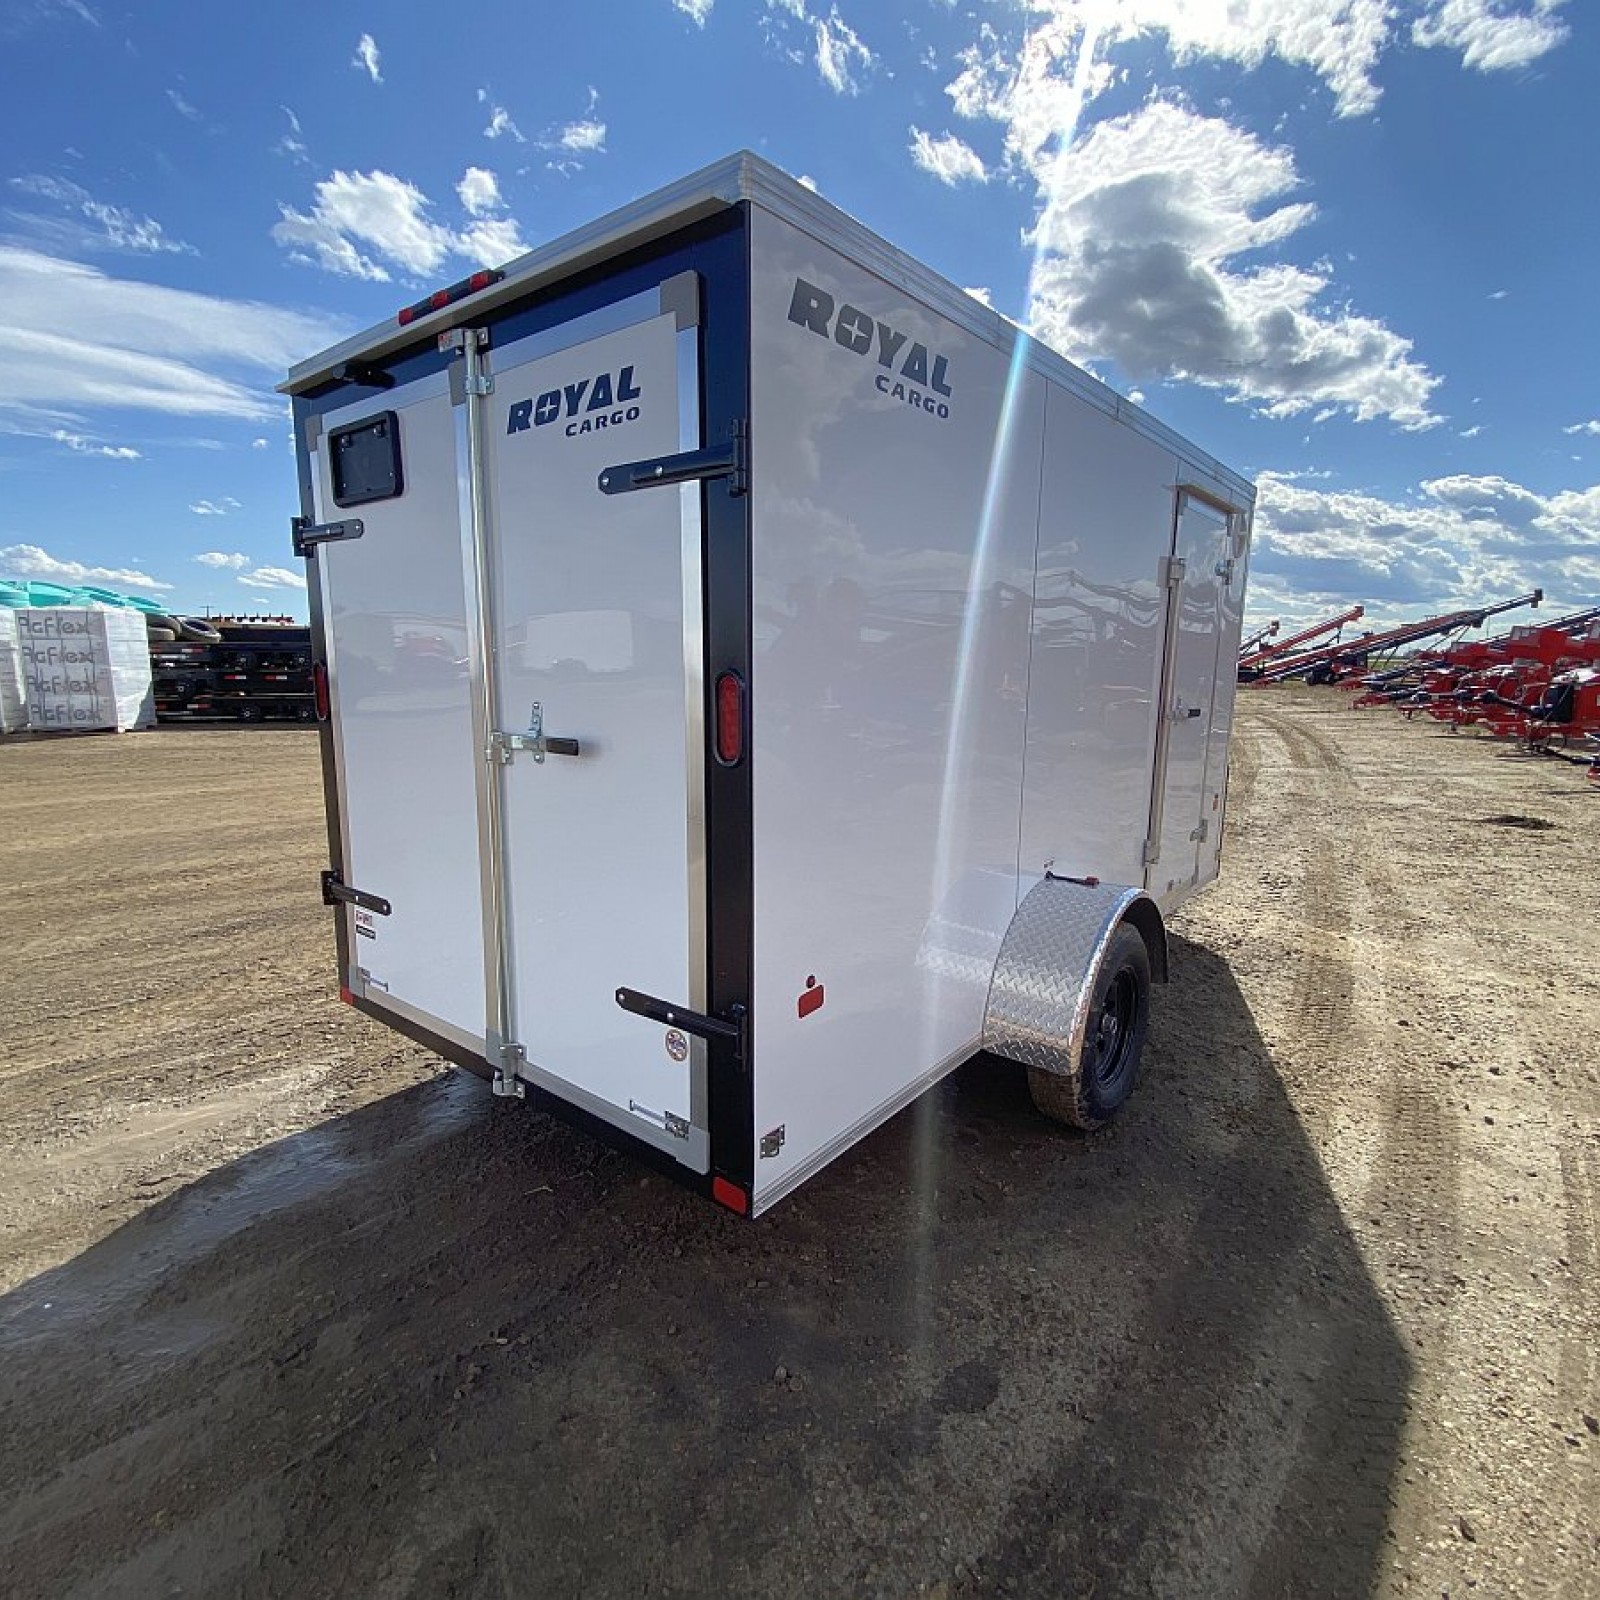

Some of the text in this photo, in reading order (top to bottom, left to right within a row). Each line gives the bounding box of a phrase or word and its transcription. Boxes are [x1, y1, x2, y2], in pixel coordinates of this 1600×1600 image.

[788, 277, 952, 398] ROYAL
[507, 365, 641, 434] ROYAL
[565, 406, 640, 437] CARGO
[874, 374, 949, 418] CARGO
